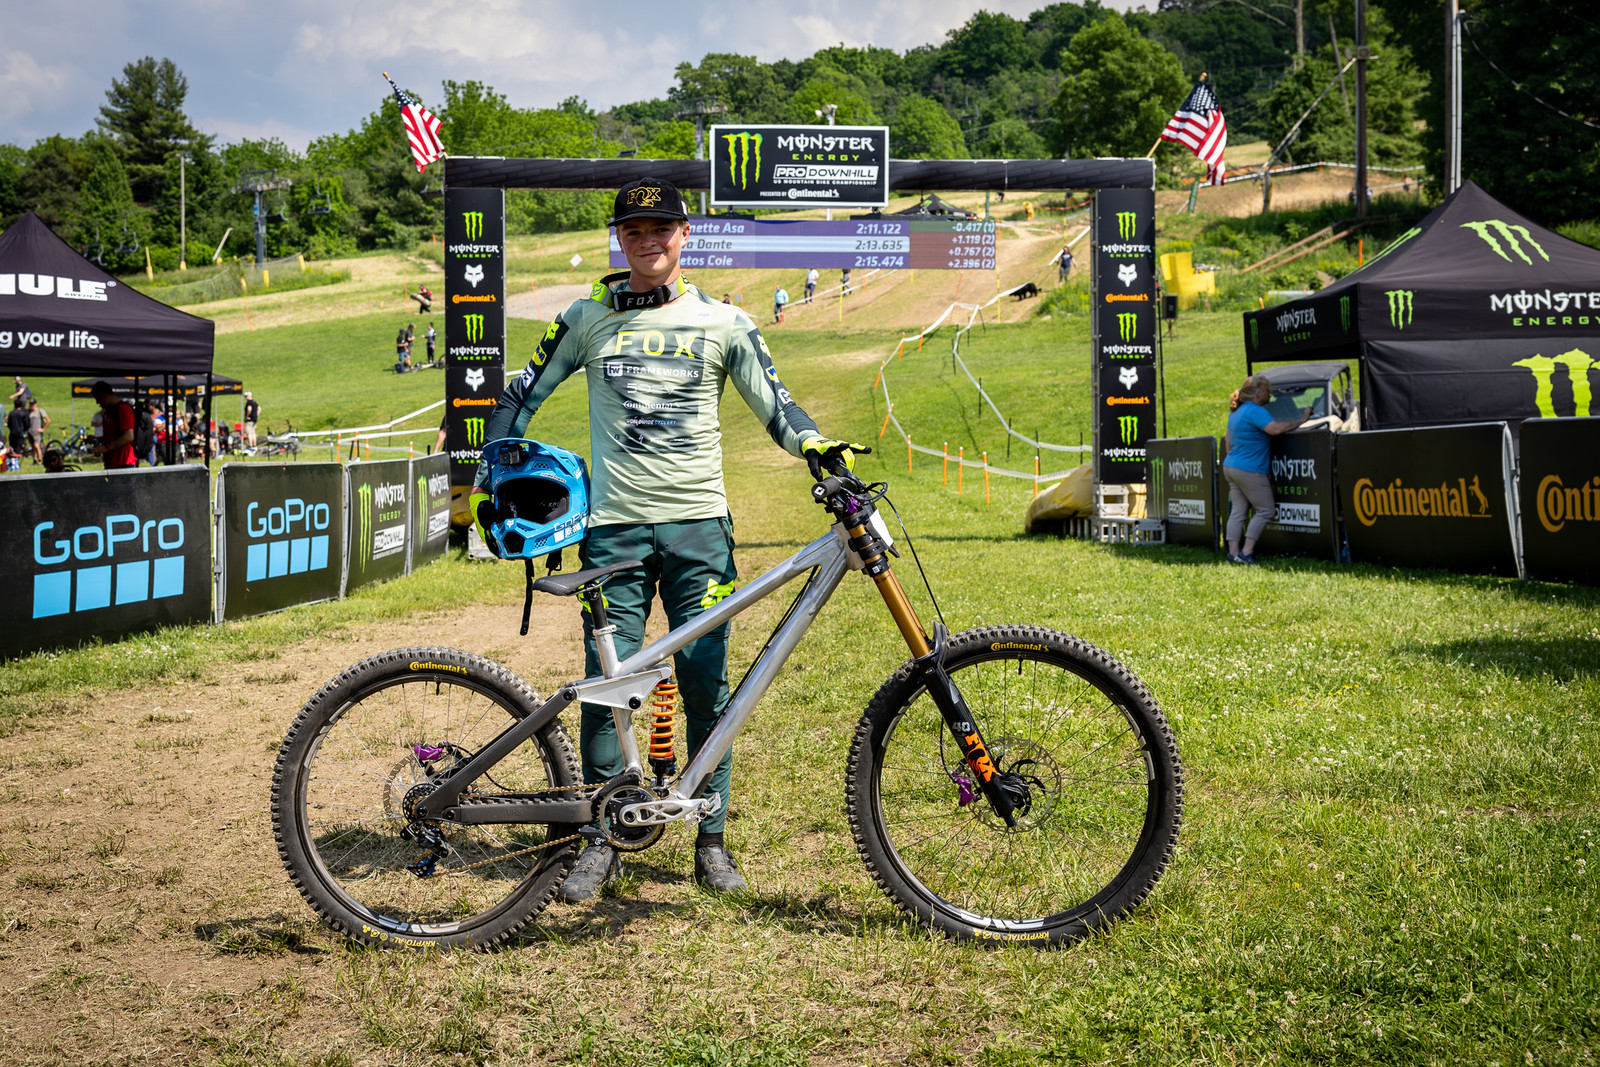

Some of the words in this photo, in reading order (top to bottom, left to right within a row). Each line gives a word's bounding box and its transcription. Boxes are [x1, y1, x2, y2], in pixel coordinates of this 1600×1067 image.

[777, 133, 875, 152] MONSTER
[776, 167, 807, 177] PRO
[808, 169, 874, 178] DOWNHILL
[626, 186, 662, 207] FOX
[788, 188, 832, 199] Continental
[722, 222, 745, 233] Asa
[856, 223, 902, 234] 2:11.122
[952, 222, 983, 232] -0.417
[983, 222, 996, 233] (1)
[449, 243, 500, 254] MONSTER
[697, 239, 733, 249] Dante
[855, 240, 903, 250] 2:13.635
[952, 234, 981, 244] +1.119
[981, 234, 996, 245] (2)
[1102, 243, 1152, 254] MONSTER
[948, 247, 981, 256] +0.767
[981, 246, 995, 257] (2)
[680, 255, 705, 266] etos
[707, 255, 733, 266] Cole
[854, 256, 904, 267] 2:15.474
[981, 258, 995, 269] (2)
[452, 294, 490, 304] Continental
[626, 294, 655, 307] FOX
[1105, 293, 1143, 303] Continental
[1489, 289, 1600, 315] MONSTE
[1276, 308, 1317, 332] MONSTER
[18, 331, 65, 350] your
[69, 330, 104, 349] life.
[614, 330, 696, 359] FOX
[450, 345, 500, 356] MONSTER
[1103, 344, 1152, 355] MONSTER
[626, 366, 699, 378] FRAMEWORKS
[453, 398, 491, 408] Continental
[1106, 396, 1144, 406] Continental
[451, 449, 483, 460] MONS
[1104, 447, 1146, 458] MONSTE
[1168, 457, 1203, 479] MONSTER
[1271, 455, 1317, 481] ONSTER
[428, 472, 449, 497] MONSTER
[1173, 484, 1198, 493] ENERGY
[1277, 486, 1308, 496] NERGY
[374, 481, 406, 509] MONSTER
[1353, 477, 1471, 526] Continental
[1179, 503, 1204, 516] DOWNHILL
[1536, 474, 1600, 532] Conti
[246, 498, 330, 538] GoPro
[379, 510, 401, 522] ENERGY
[554, 508, 589, 532] GoPro
[1281, 507, 1319, 523] DOWNHILL
[33, 513, 185, 565] GoPro
[990, 641, 1042, 652] Continental
[409, 661, 460, 673] Continental
[964, 730, 998, 783] FOX
